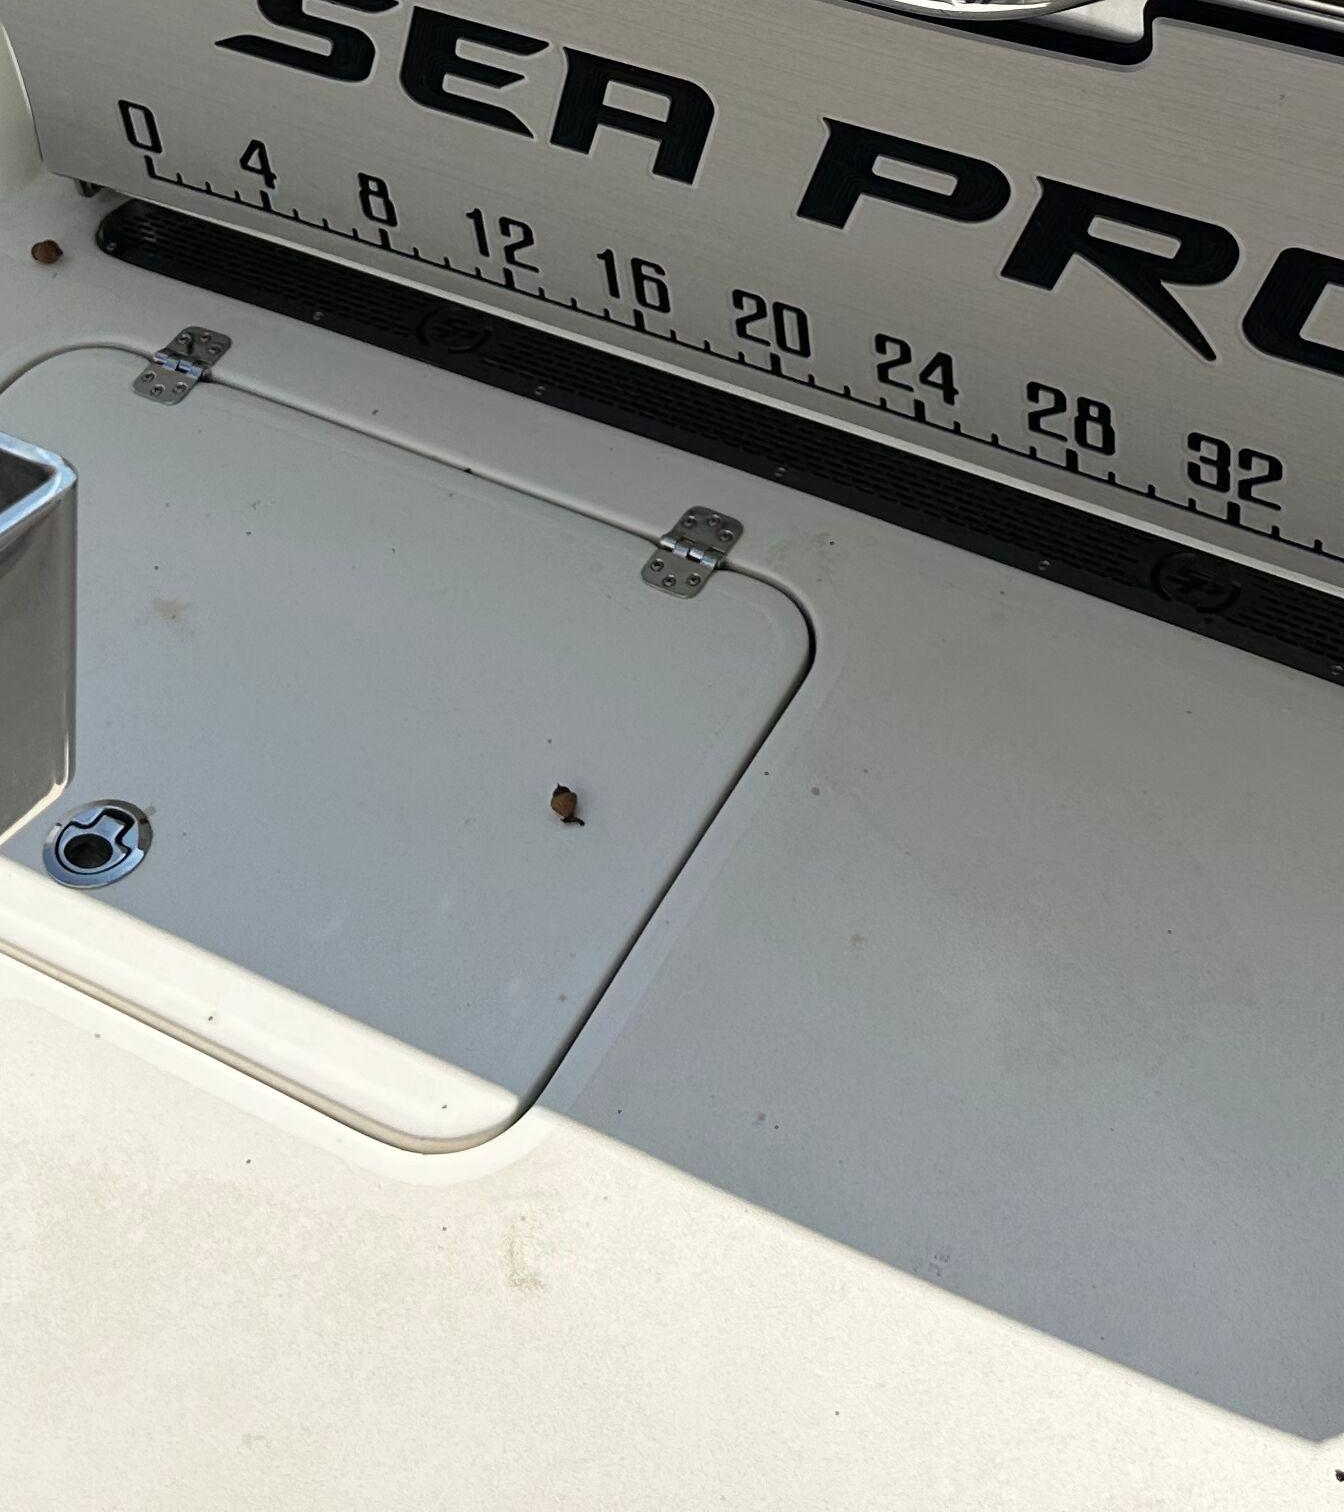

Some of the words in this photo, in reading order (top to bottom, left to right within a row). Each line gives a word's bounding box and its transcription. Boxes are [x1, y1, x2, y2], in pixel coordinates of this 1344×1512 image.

[118, 99, 162, 154] 0
[239, 139, 277, 189] 4
[357, 172, 398, 228] 8
[465, 207, 540, 274] 12
[596, 248, 671, 314] 16
[731, 288, 812, 359] 20
[874, 333, 960, 407] 24
[1026, 381, 1116, 457] 28
[1186, 431, 1284, 512] 32
